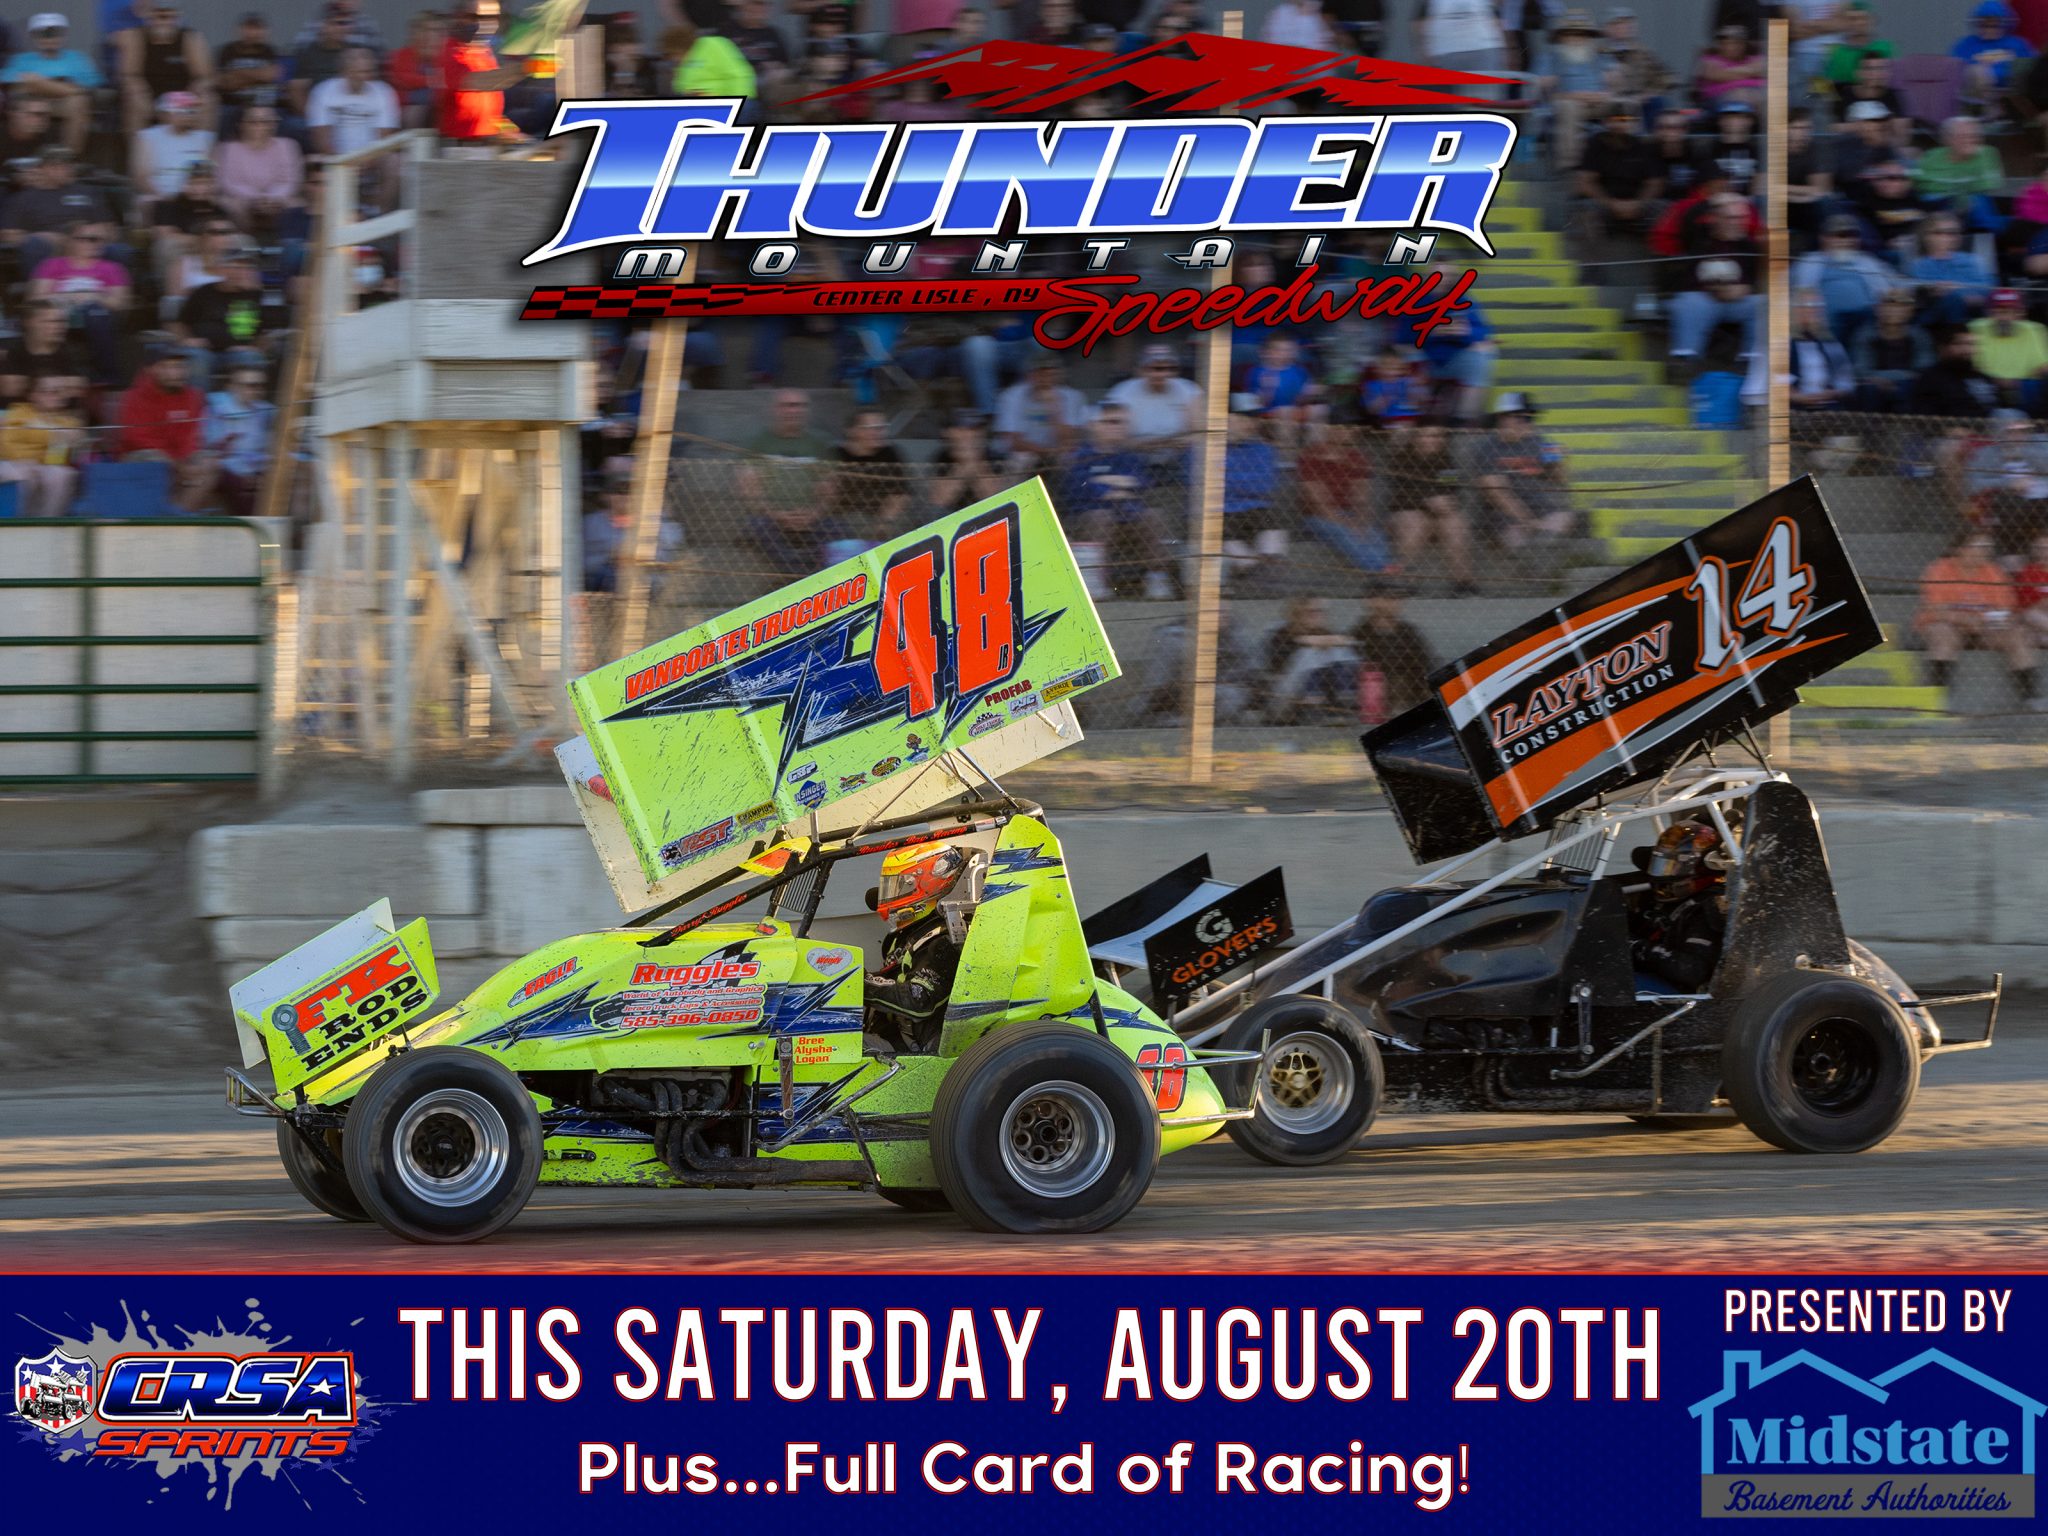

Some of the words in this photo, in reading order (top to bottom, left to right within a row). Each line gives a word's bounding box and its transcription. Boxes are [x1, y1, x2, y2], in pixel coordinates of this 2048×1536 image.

[871, 501, 1024, 723] 48
[1684, 517, 1815, 674] 14
[626, 625, 749, 703] VANBORTEL
[752, 574, 867, 648] TRUCKING
[997, 644, 1009, 671] JR
[984, 679, 1032, 707] PROFAB
[1492, 621, 1672, 748] LAYTON
[1501, 664, 1674, 764] CONSTRUCTION
[1195, 909, 1234, 944] G
[1172, 917, 1278, 983] GLOVER'S
[293, 945, 412, 1034] FK
[525, 957, 576, 997] EAGLE
[631, 959, 760, 986] Ruggles
[319, 975, 418, 1040] ROD
[623, 991, 649, 1000] World
[650, 991, 661, 999] of
[663, 988, 705, 998] Autobody
[706, 986, 723, 995] and
[725, 984, 764, 995] Graphics
[653, 1003, 677, 1011] Truck
[678, 1002, 700, 1011] Caps
[701, 1000, 708, 1008] &
[301, 988, 428, 1072] ENDS
[621, 1008, 760, 1030] 585-396-0850
[794, 1044, 833, 1056] Alysha
[799, 1037, 825, 1045] Bree
[795, 1055, 829, 1065] Logan
